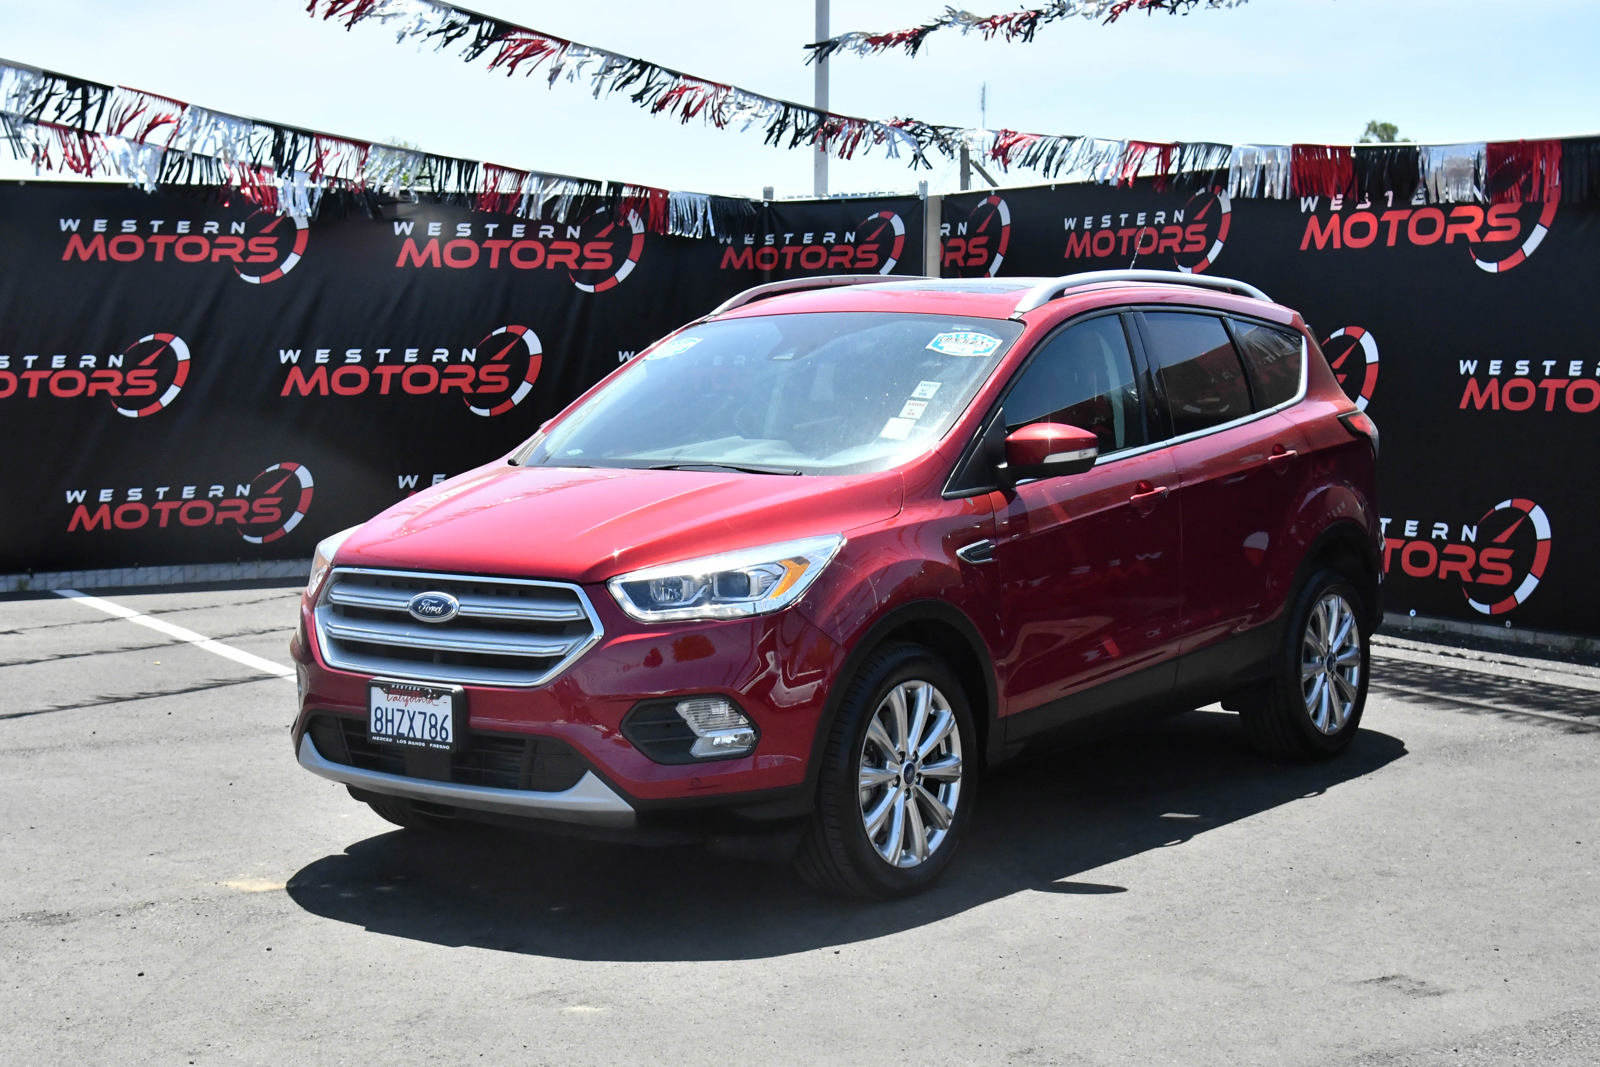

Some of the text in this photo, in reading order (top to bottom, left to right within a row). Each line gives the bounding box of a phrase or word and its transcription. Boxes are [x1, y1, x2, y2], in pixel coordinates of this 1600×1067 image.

[59, 218, 246, 234] WESTERN
[393, 221, 581, 239] WESTERN
[1064, 209, 1184, 230] WESTERN
[1300, 200, 1523, 250] MOTORS
[62, 234, 279, 263] MOTORS
[718, 231, 856, 246] WESTERN
[1064, 223, 1208, 259] MOTORS
[395, 238, 614, 270] MOTORS
[720, 244, 880, 271] MOTORS
[280, 348, 476, 364] WESTERN
[280, 364, 511, 397] MOTORS
[66, 484, 250, 503] WESTERN
[66, 497, 283, 532] MOTORS
[418, 598, 444, 614] Ford
[374, 706, 450, 743] 8HZX786
[371, 735, 393, 743] MERCED
